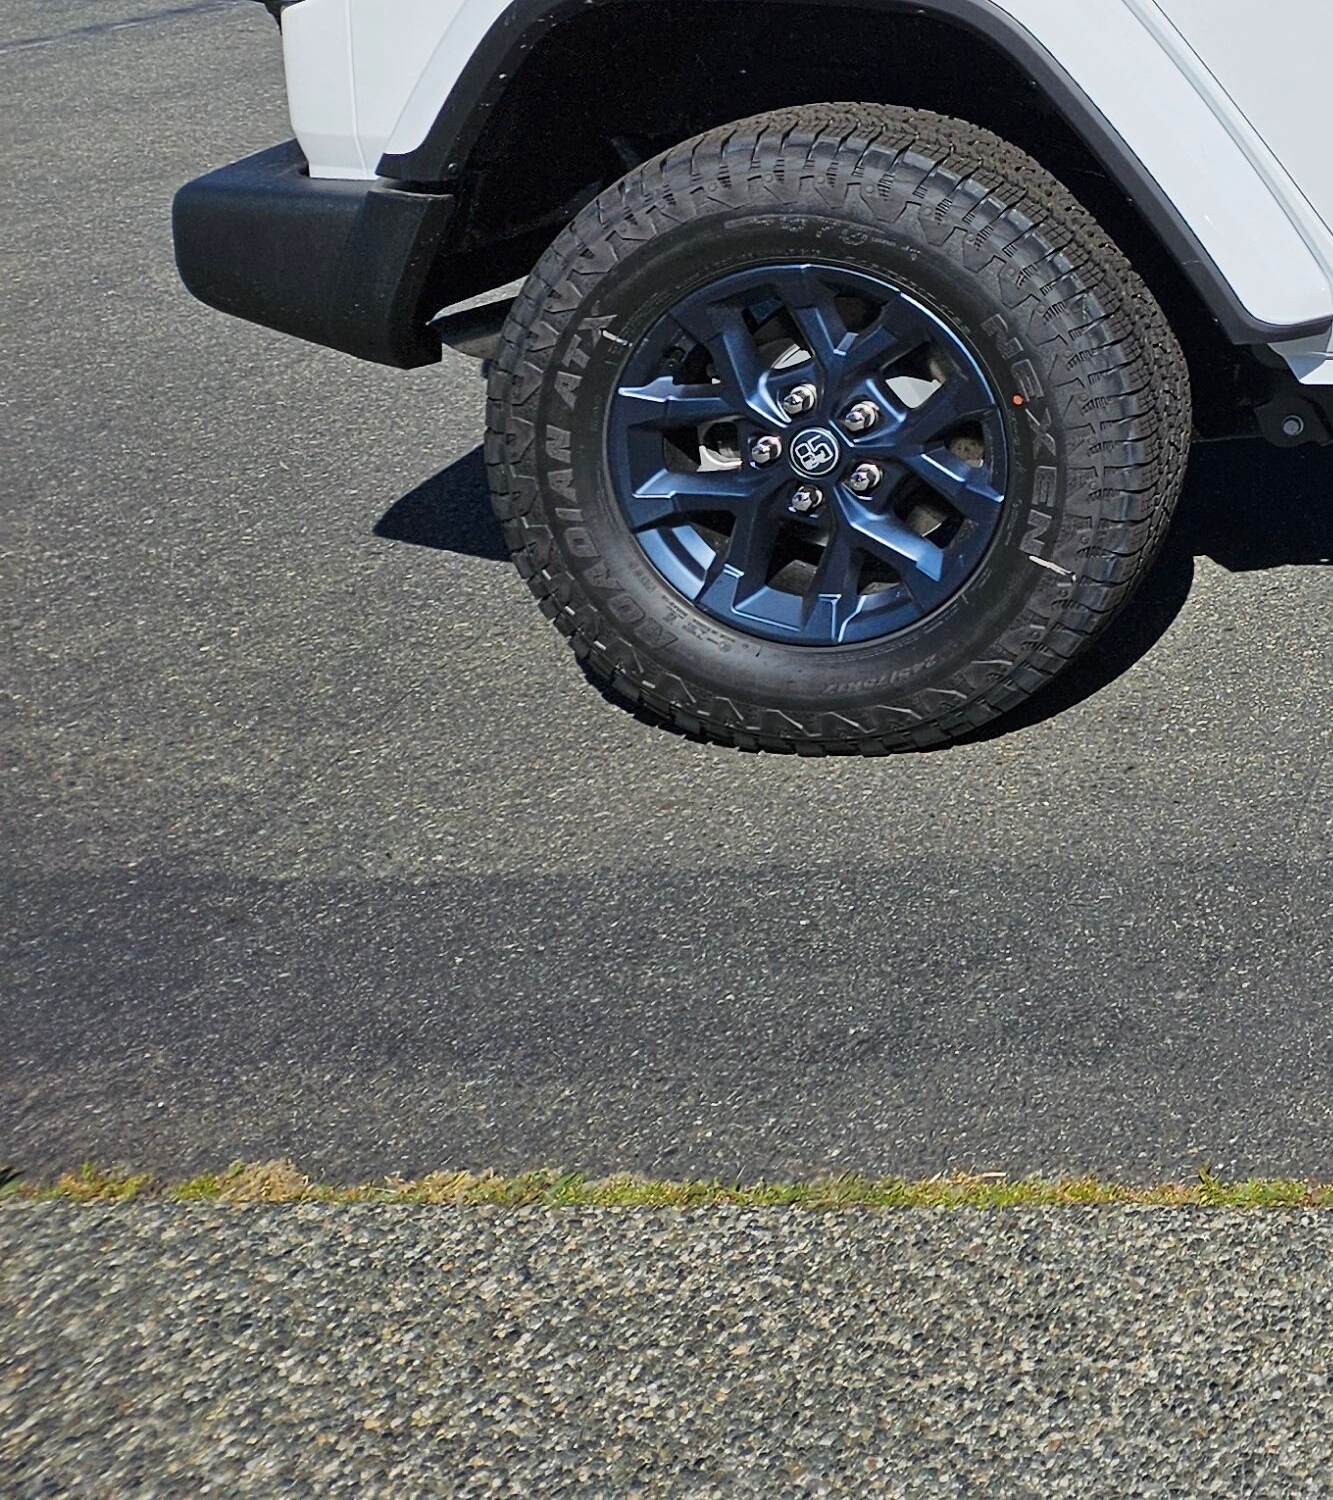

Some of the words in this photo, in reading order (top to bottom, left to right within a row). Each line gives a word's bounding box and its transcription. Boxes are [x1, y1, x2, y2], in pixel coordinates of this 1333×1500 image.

[554, 301, 618, 410] ATX
[980, 313, 1058, 557] NEXEN
[794, 434, 834, 470] 85
[546, 424, 679, 651] ROADIAN
